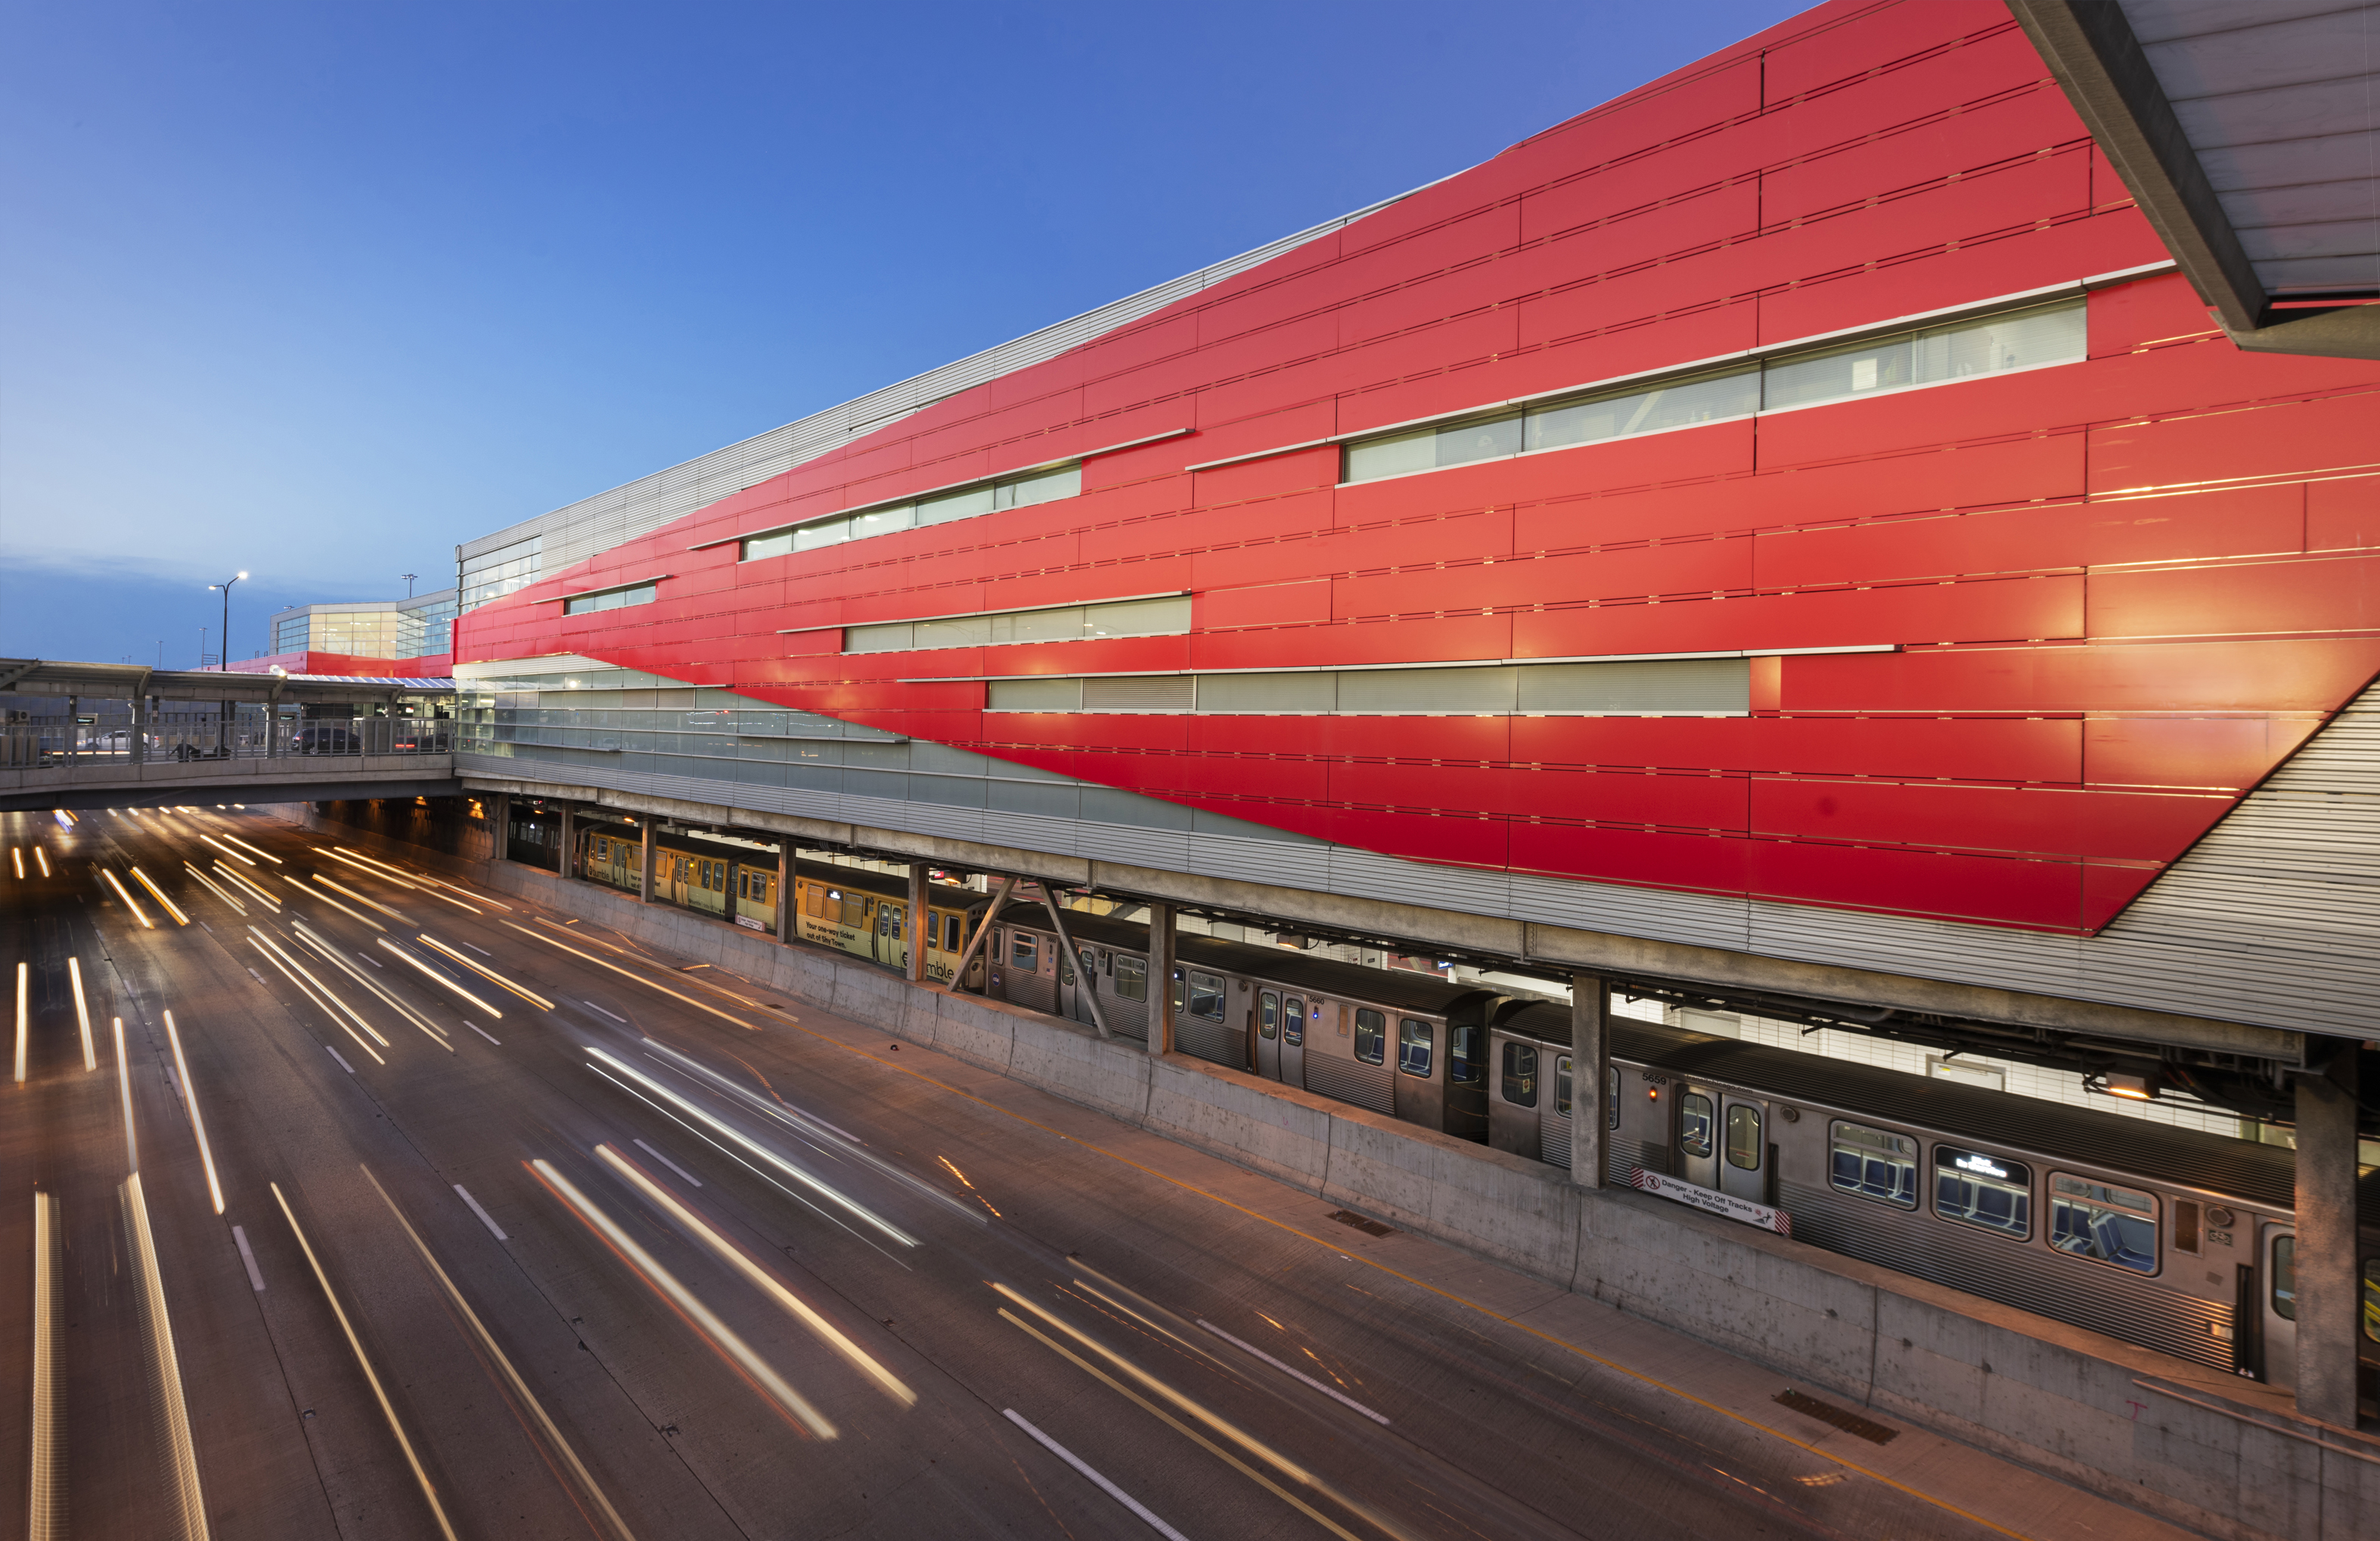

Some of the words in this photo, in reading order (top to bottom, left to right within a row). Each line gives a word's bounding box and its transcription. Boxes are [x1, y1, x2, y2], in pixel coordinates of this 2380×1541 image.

[806, 921, 817, 930] Your
[818, 926, 839, 937] one-way
[839, 930, 855, 941] ticket
[1309, 996, 1325, 1005] 5660
[1642, 1073, 1667, 1086] 5659
[1662, 1179, 1687, 1192] Danger
[1693, 1189, 1712, 1201] Keep
[1714, 1195, 1726, 1204] Off
[1727, 1199, 1752, 1213] Tracks
[1683, 1194, 1700, 1204] High
[1702, 1198, 1730, 1213] Voltage
